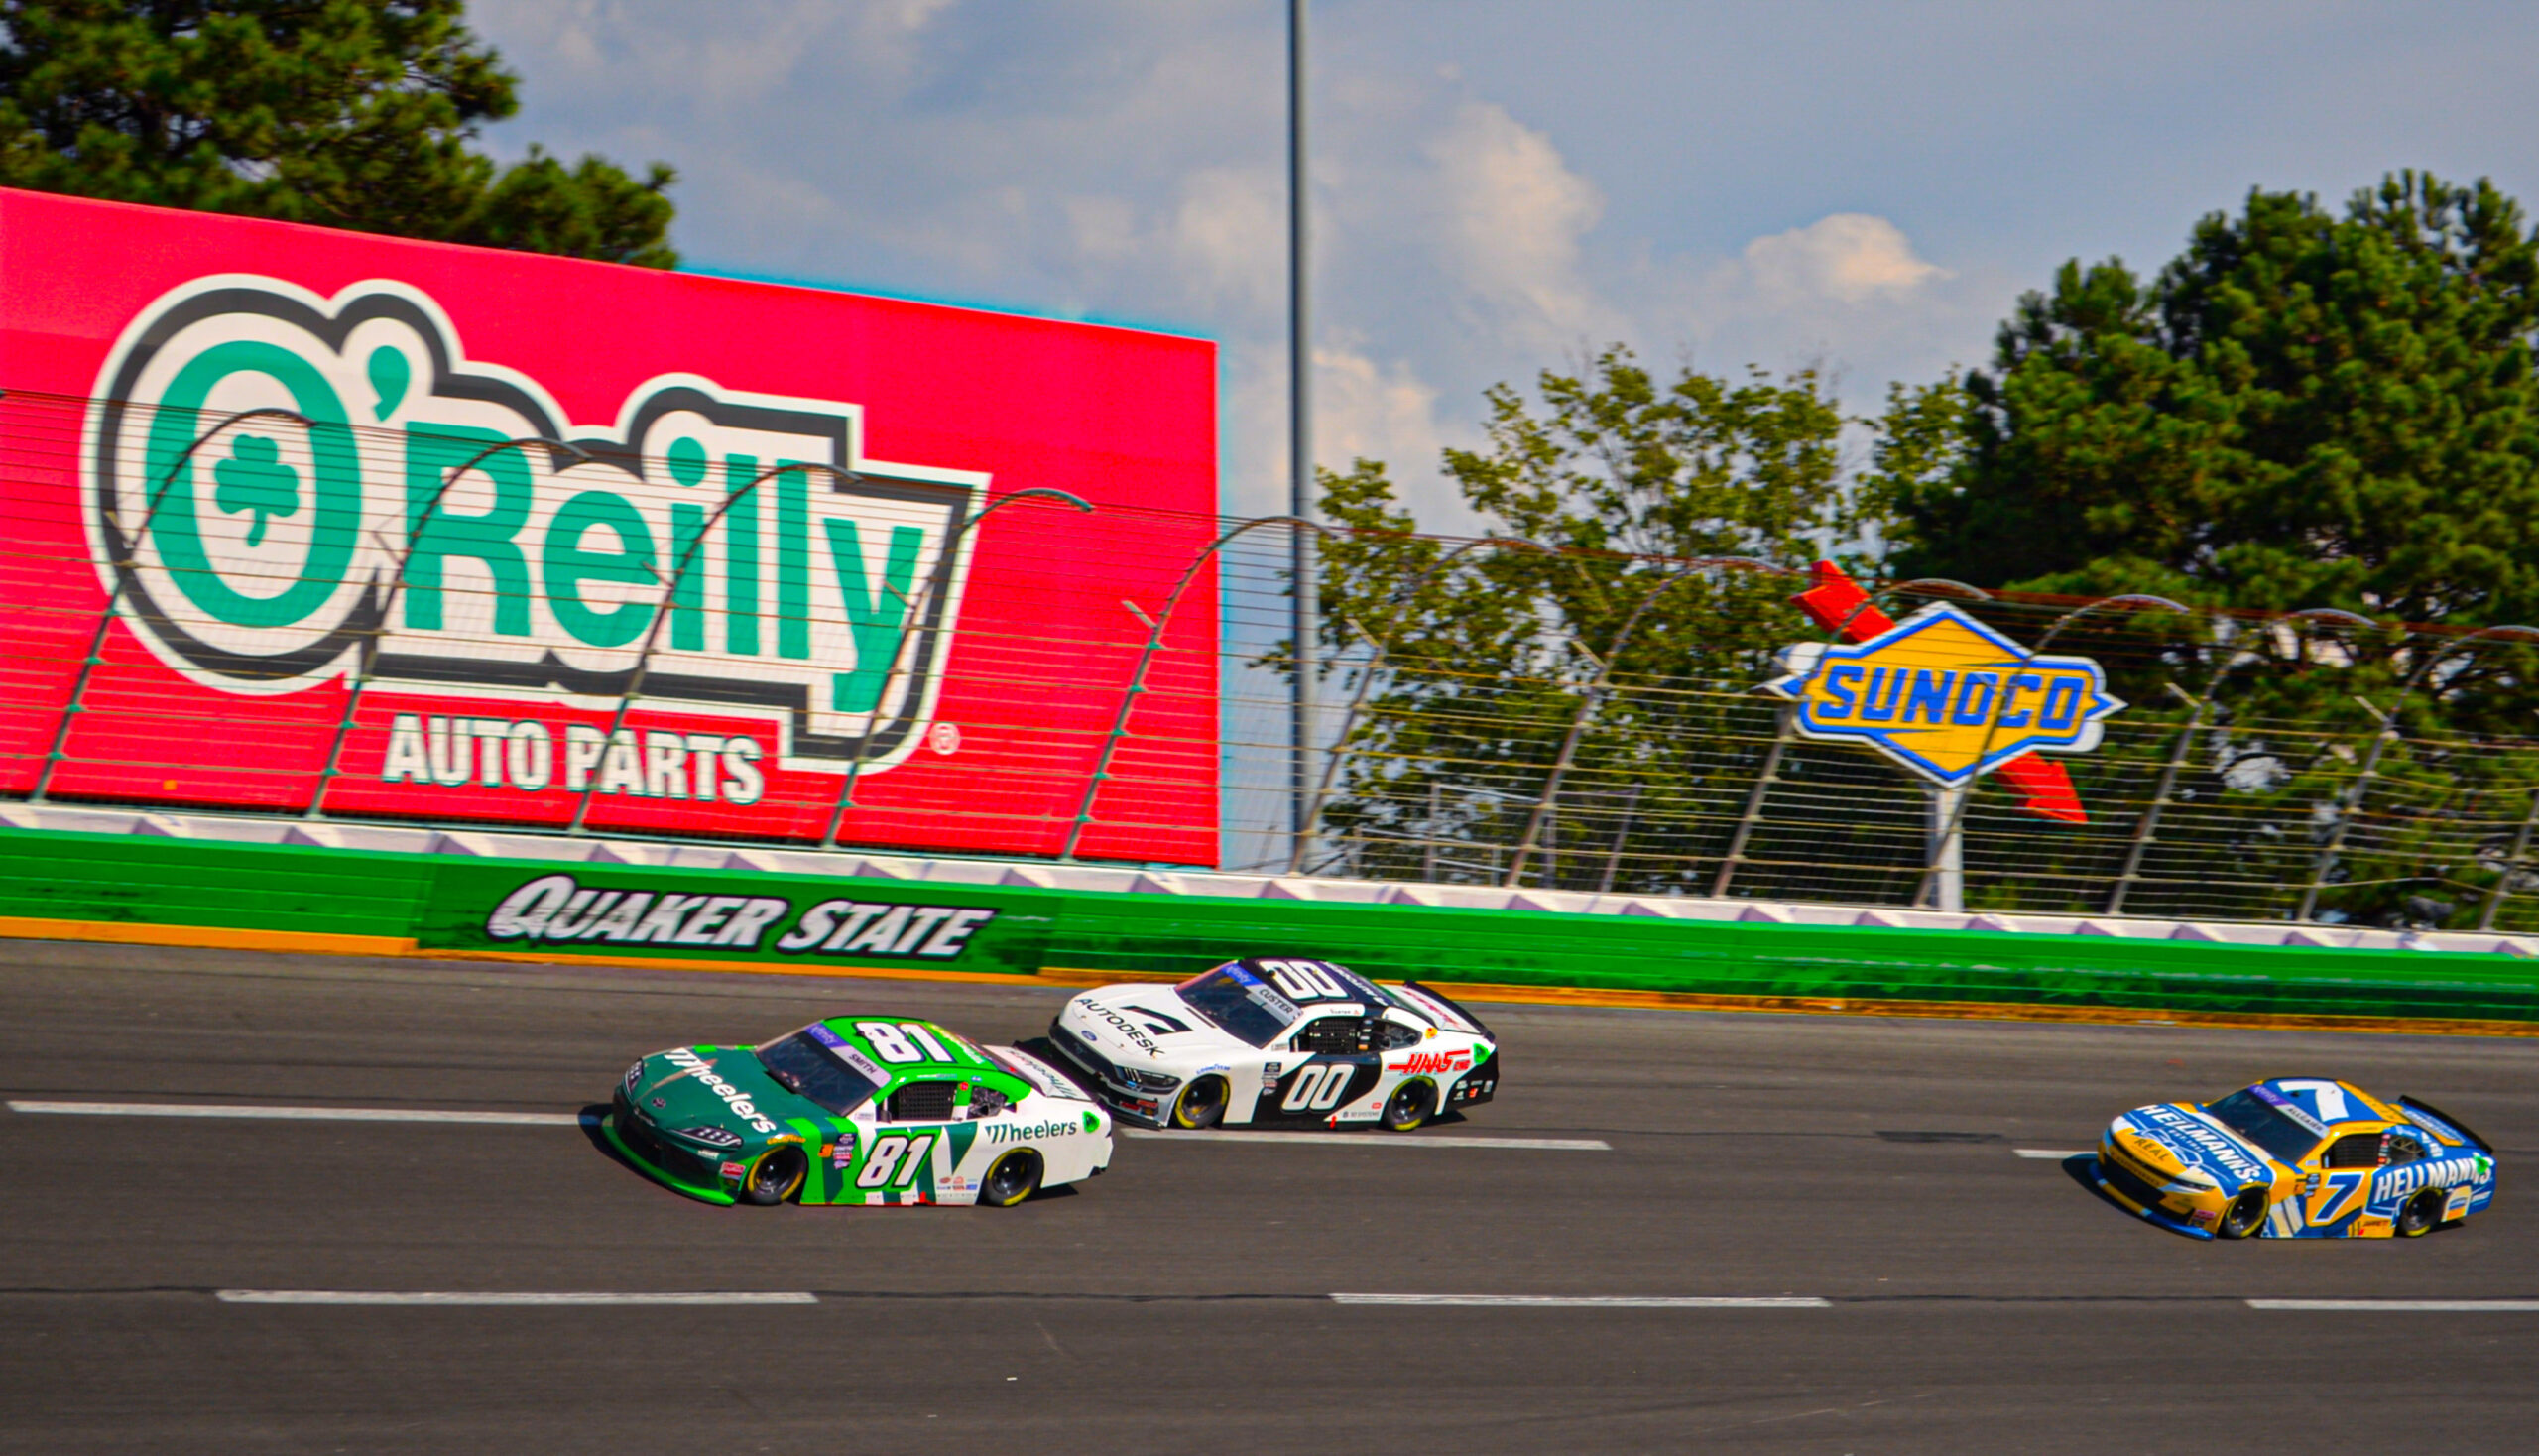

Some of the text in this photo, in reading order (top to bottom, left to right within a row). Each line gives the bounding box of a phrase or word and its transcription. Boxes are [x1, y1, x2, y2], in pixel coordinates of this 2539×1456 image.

[146, 339, 923, 713] O'Reilly
[1817, 665, 2085, 730] SUNOCO
[382, 713, 765, 805] AUTO PARTS
[487, 875, 996, 956] QUAKER STATE
[1259, 988, 1294, 1014] CUSTER
[853, 1021, 957, 1064] 81
[1074, 998, 1166, 1057] AUTODESK
[849, 1053, 878, 1075] SMITH
[1281, 1063, 1356, 1111] 00
[2277, 1081, 2350, 1122] 7
[985, 1119, 1078, 1144] Wheelers
[2134, 1138, 2170, 1161] REAL
[856, 1134, 935, 1188] 81
[2312, 1171, 2366, 1222] 7
